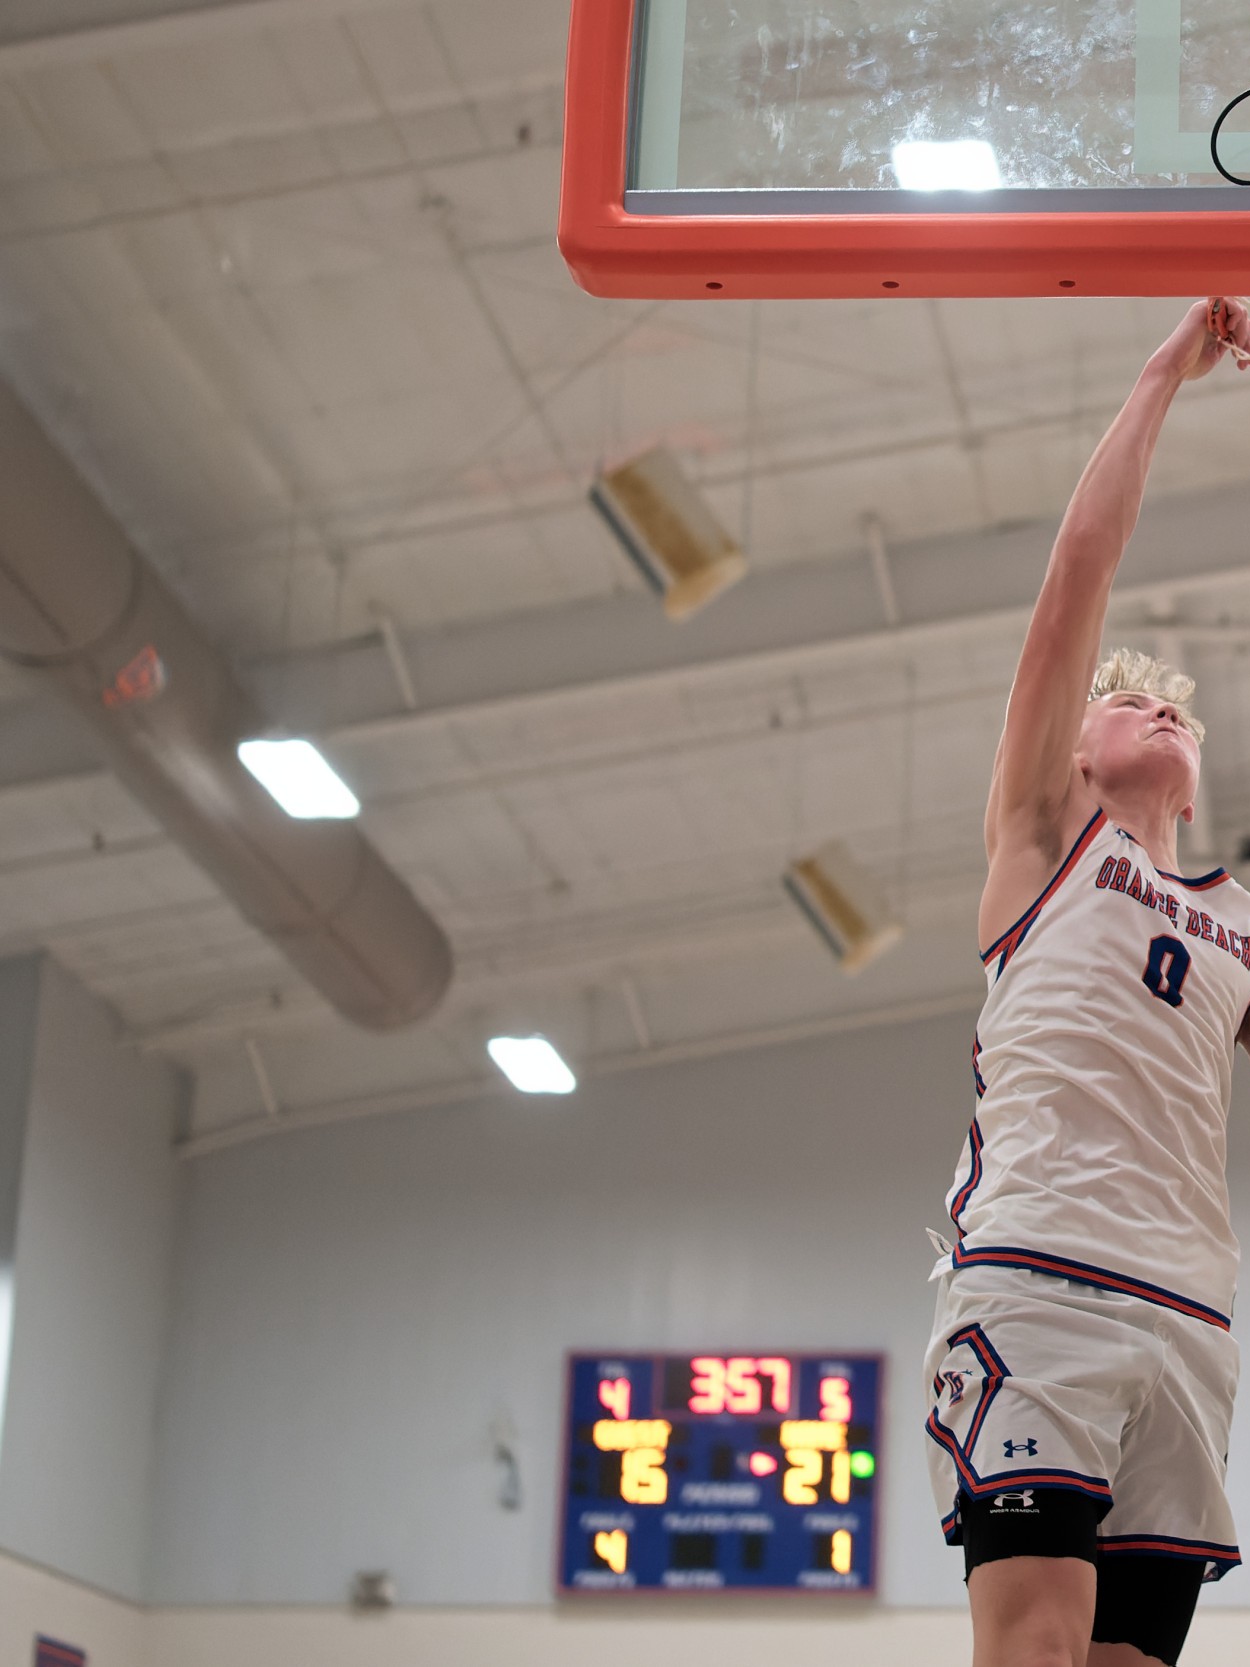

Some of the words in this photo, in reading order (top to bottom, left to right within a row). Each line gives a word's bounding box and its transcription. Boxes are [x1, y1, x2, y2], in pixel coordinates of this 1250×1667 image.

[1096, 855, 1180, 929] ORANGE
[1142, 933, 1192, 1008] 0
[599, 1377, 631, 1420] 4
[819, 1377, 851, 1422] 5
[783, 1449, 850, 1505] 21
[594, 1529, 627, 1574] 4
[831, 1529, 851, 1574] 1
